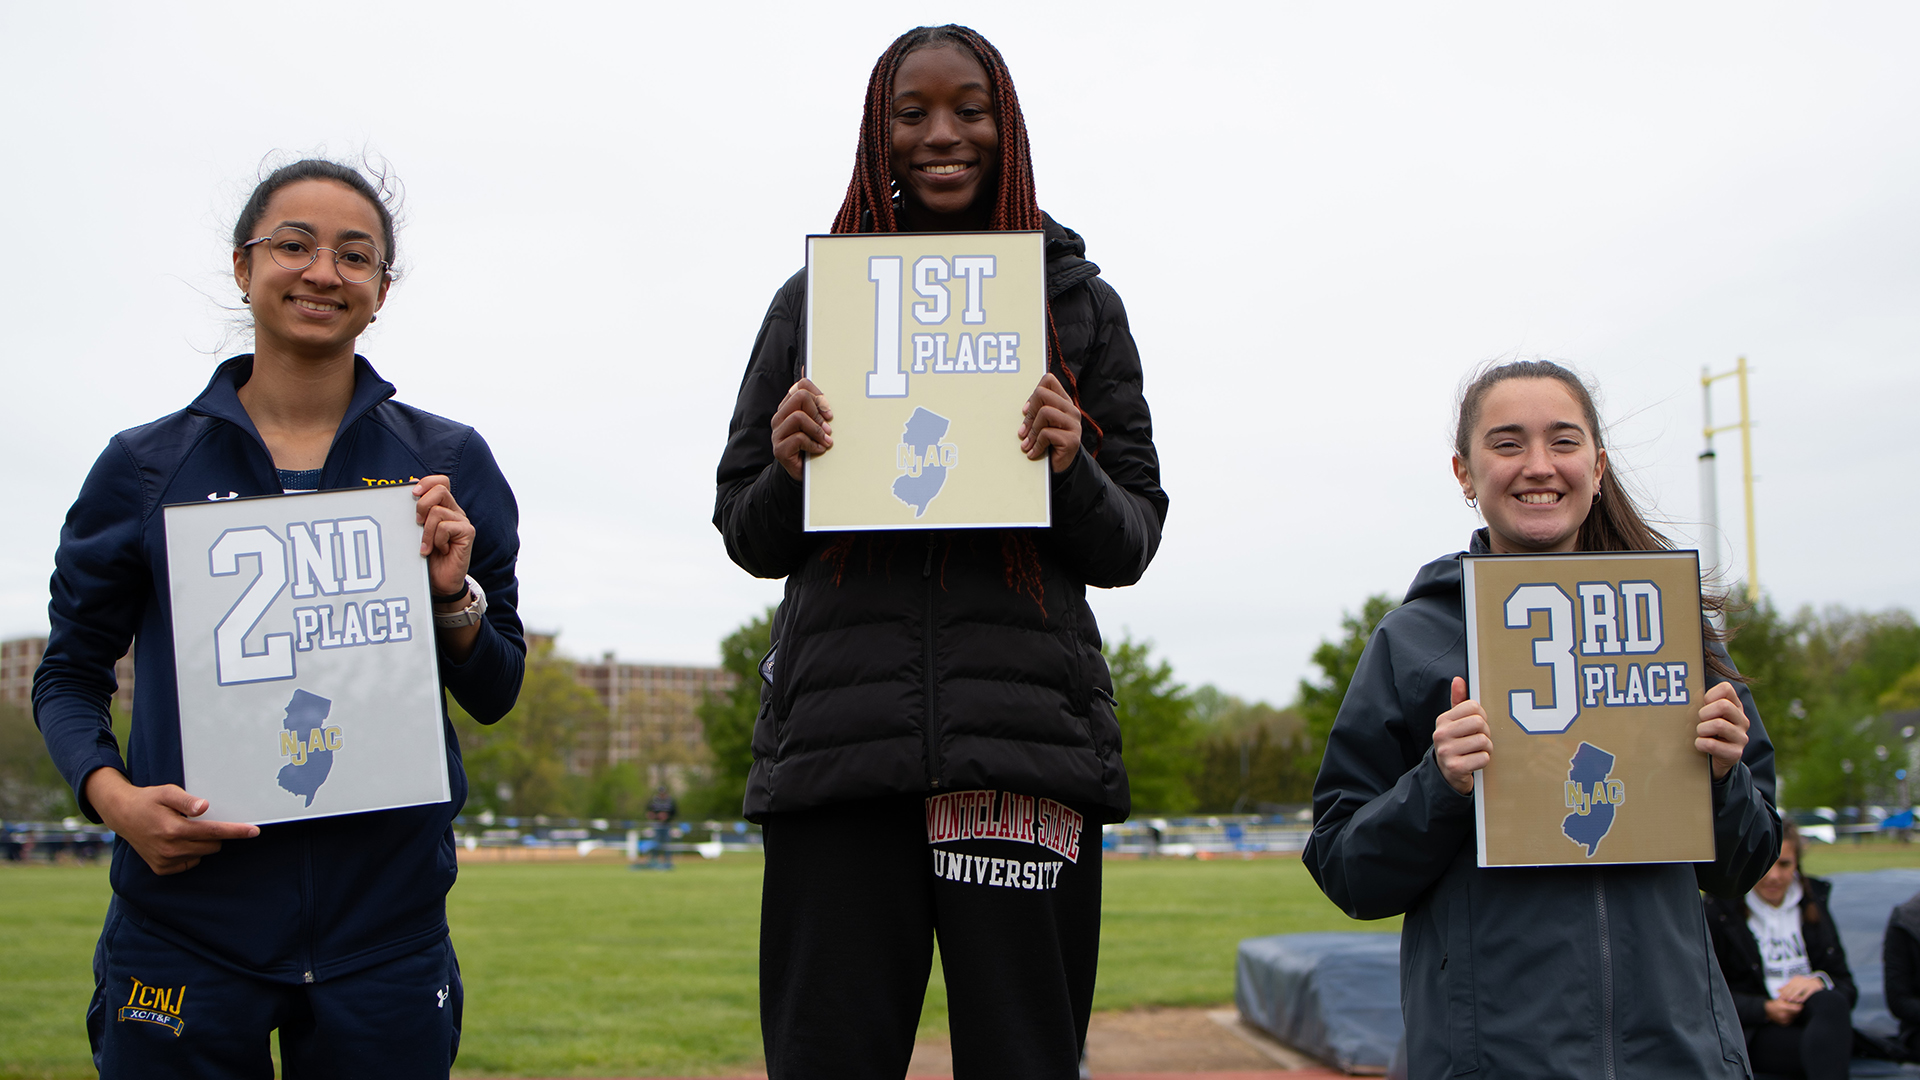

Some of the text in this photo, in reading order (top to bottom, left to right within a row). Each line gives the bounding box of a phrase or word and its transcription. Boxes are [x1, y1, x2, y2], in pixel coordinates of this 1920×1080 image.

[866, 255, 996, 398] 1ST
[911, 332, 1020, 374] PLACE
[897, 443, 958, 478] NJAC
[208, 515, 386, 687] 2ND
[293, 597, 412, 652] PLACE
[1503, 580, 1665, 735] 3RD
[1582, 662, 1690, 707] PLACE
[279, 725, 343, 766] NJAC
[1565, 779, 1625, 816] NJAC
[925, 790, 1083, 864] MONTCLAIR STATE
[933, 849, 1063, 890] UNIVERSITY
[127, 976, 186, 1015] TCNJ
[130, 1009, 171, 1024] XC/T&F
